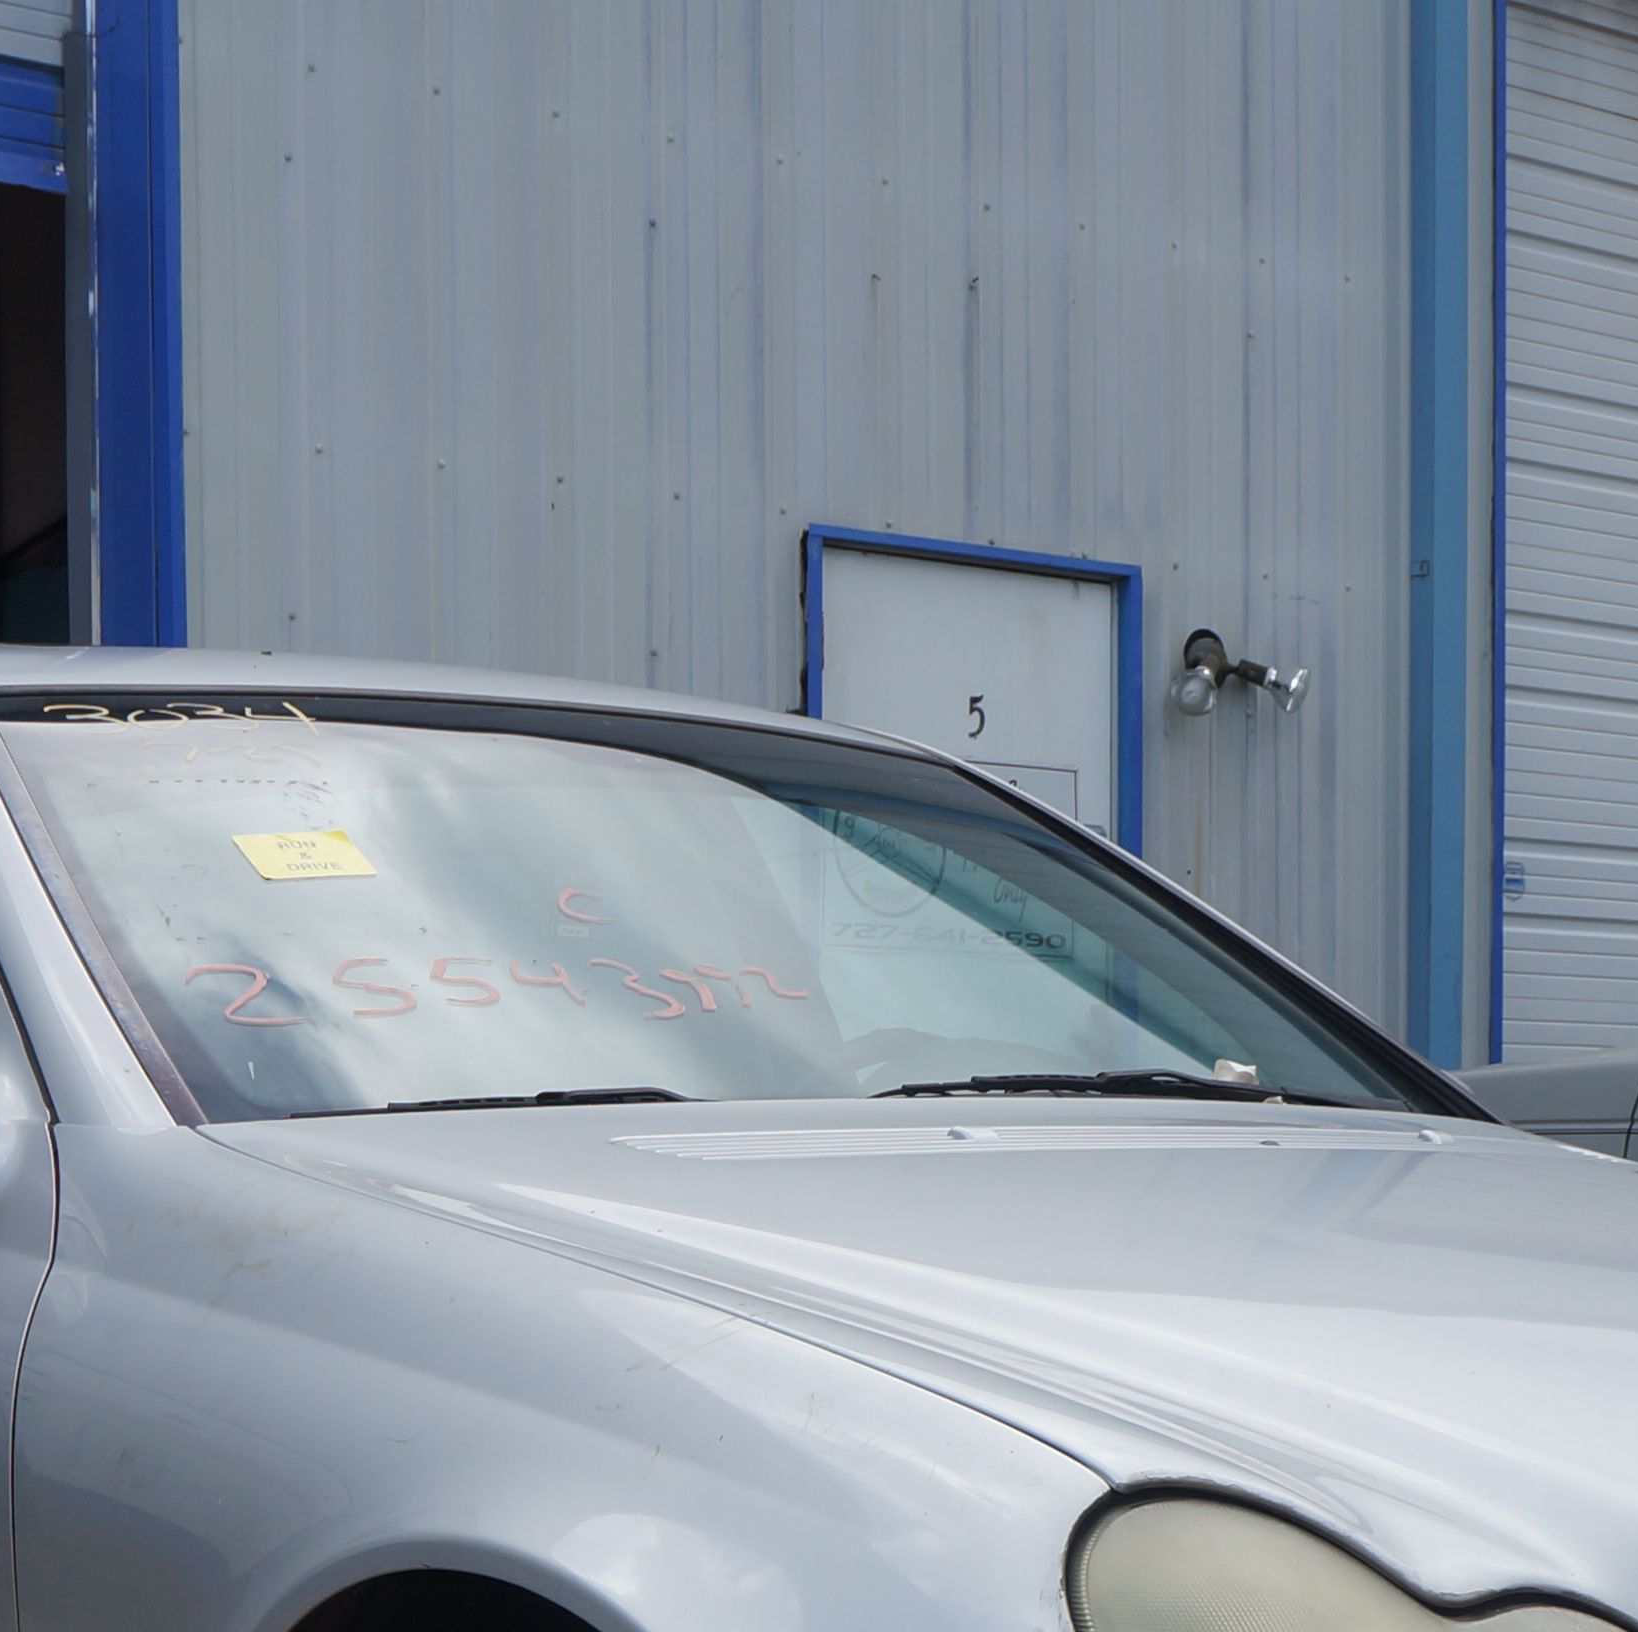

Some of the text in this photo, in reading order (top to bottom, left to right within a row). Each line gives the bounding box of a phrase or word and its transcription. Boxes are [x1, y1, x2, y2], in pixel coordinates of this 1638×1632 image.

[43, 701, 320, 735] 3034
[967, 693, 986, 740] 5
[277, 839, 317, 852] RUN
[285, 860, 345, 872] DRIVE
